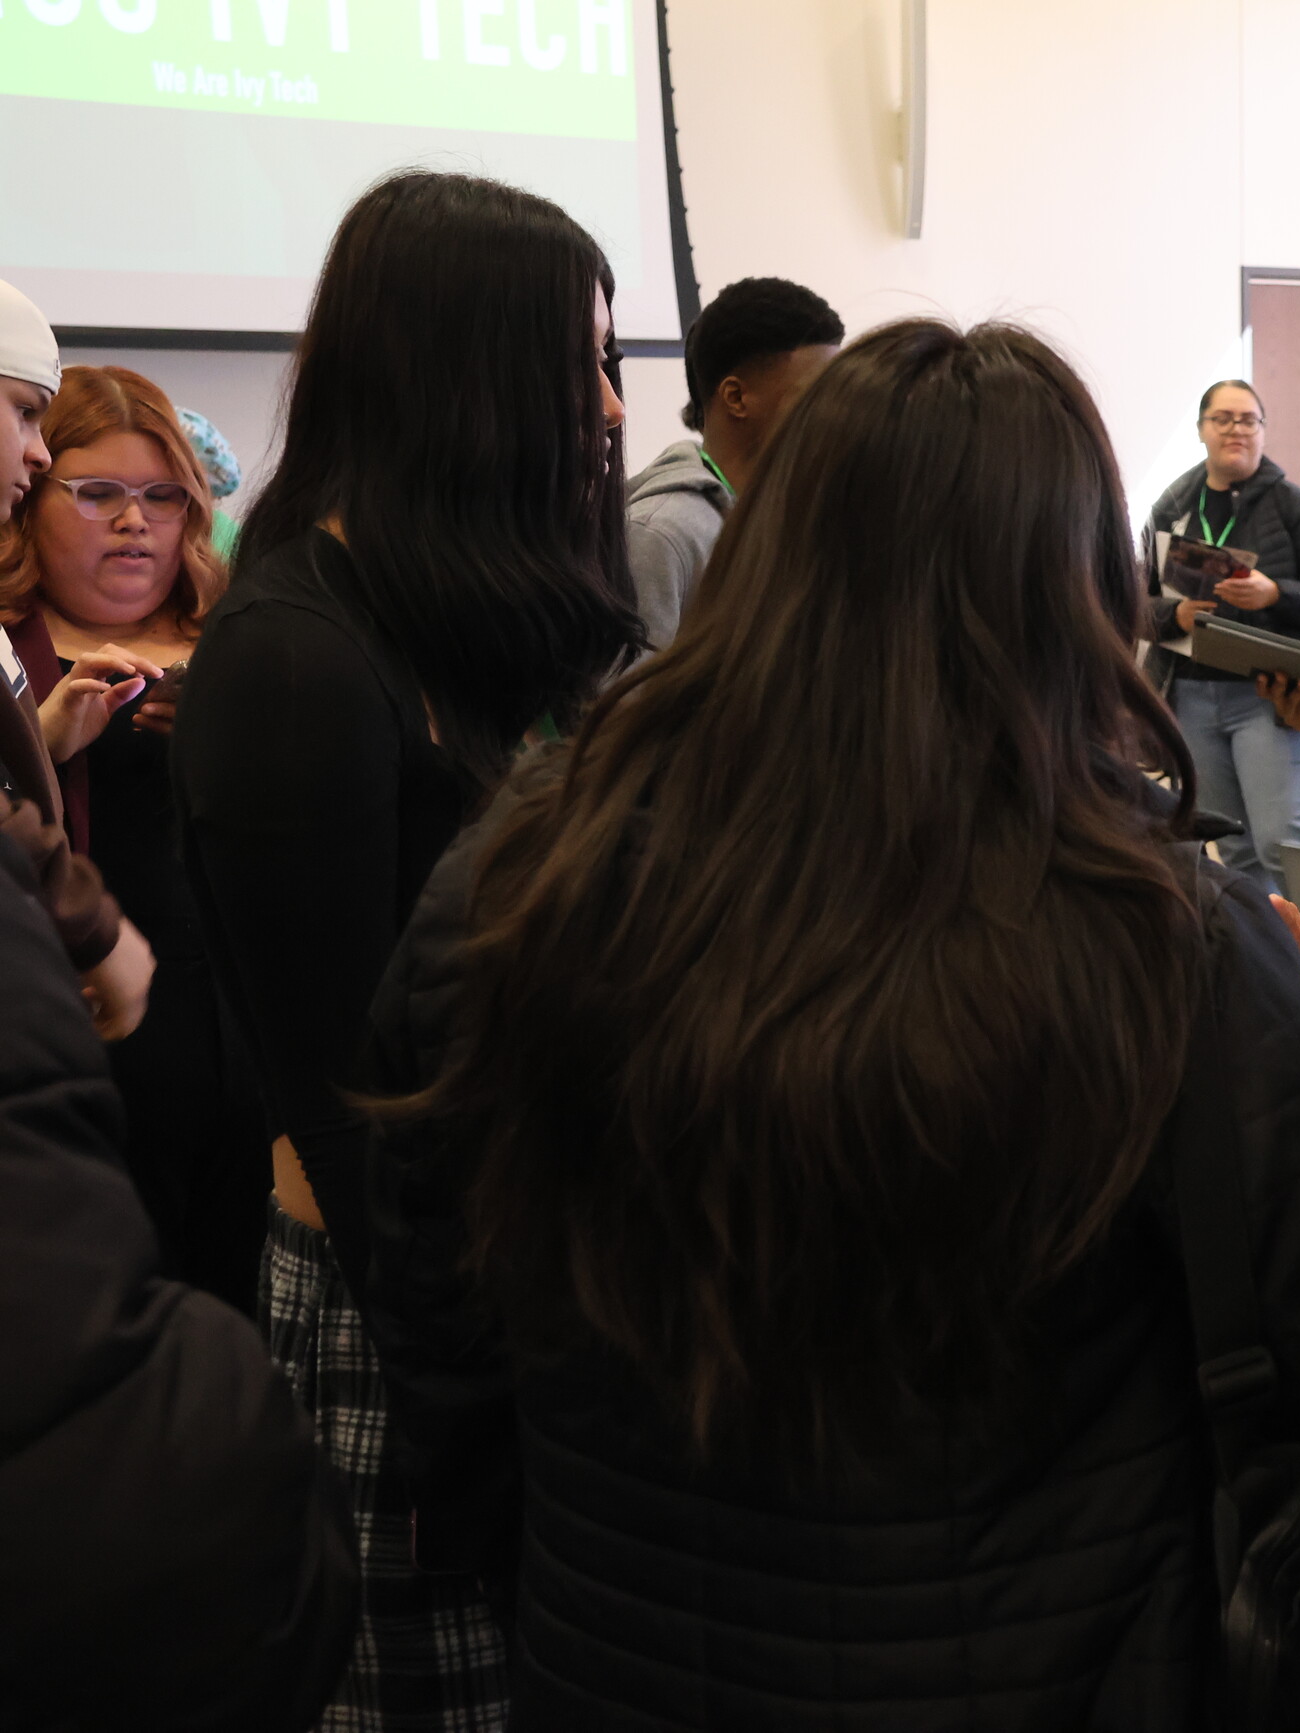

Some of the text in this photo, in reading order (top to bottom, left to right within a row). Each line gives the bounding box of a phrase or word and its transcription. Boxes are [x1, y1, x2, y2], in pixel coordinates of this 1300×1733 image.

[152, 60, 319, 107] We Are Ivy Tech
